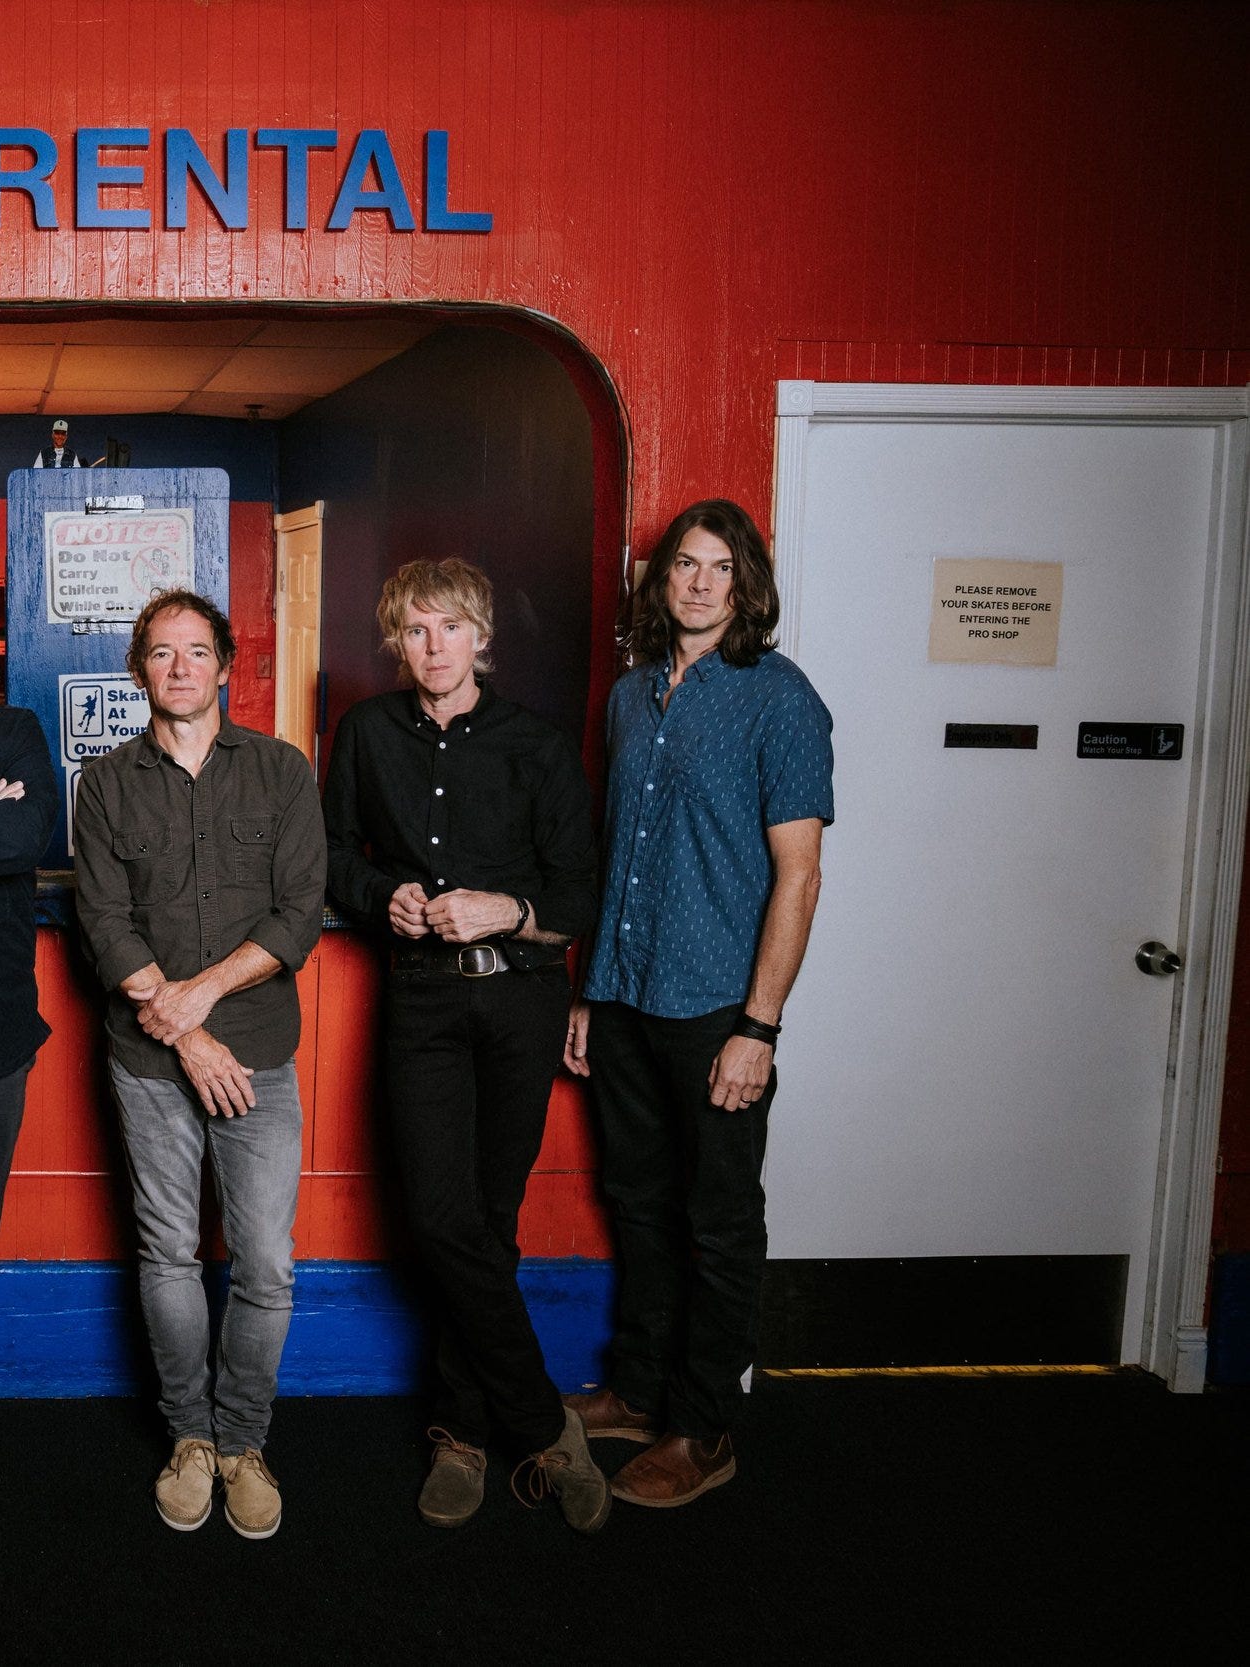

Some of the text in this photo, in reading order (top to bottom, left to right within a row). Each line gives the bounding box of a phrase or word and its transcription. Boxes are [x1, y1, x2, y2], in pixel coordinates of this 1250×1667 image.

[65, 522, 174, 544] NOTICE
[58, 550, 131, 564] Do Not
[58, 568, 98, 581] Carry
[59, 584, 119, 596] Children
[955, 585, 1037, 597] PLEASE REMOVE
[59, 601, 101, 613] While
[941, 599, 1052, 612] YOUR SKATES BEFORE
[959, 615, 1031, 625] ENTERING THE
[968, 630, 1019, 639] PRO SHOP
[107, 690, 147, 702] Skat
[108, 708, 127, 719] At
[108, 724, 147, 736] Your
[1083, 734, 1127, 744] Caution
[74, 743, 113, 755] Own
[1082, 746, 1143, 755] Watch Your Step
